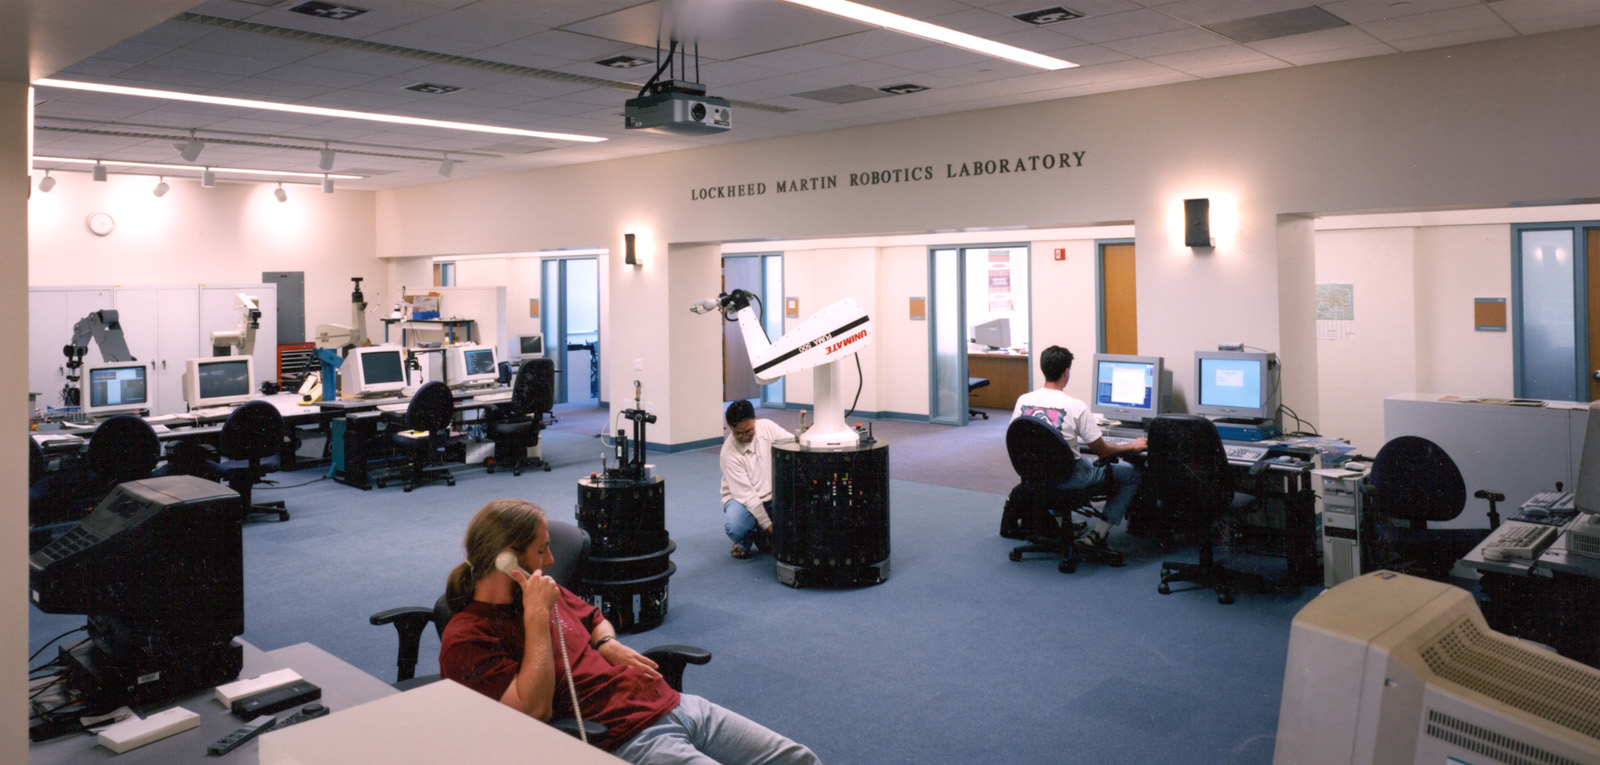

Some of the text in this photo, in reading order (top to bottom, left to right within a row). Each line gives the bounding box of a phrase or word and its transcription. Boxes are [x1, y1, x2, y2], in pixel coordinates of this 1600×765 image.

[691, 150, 1087, 201] LOCKHEED MARTIN ROBOTICS LABORATORY
[812, 332, 833, 346] PUMA
[825, 329, 867, 356] UNIMATE
